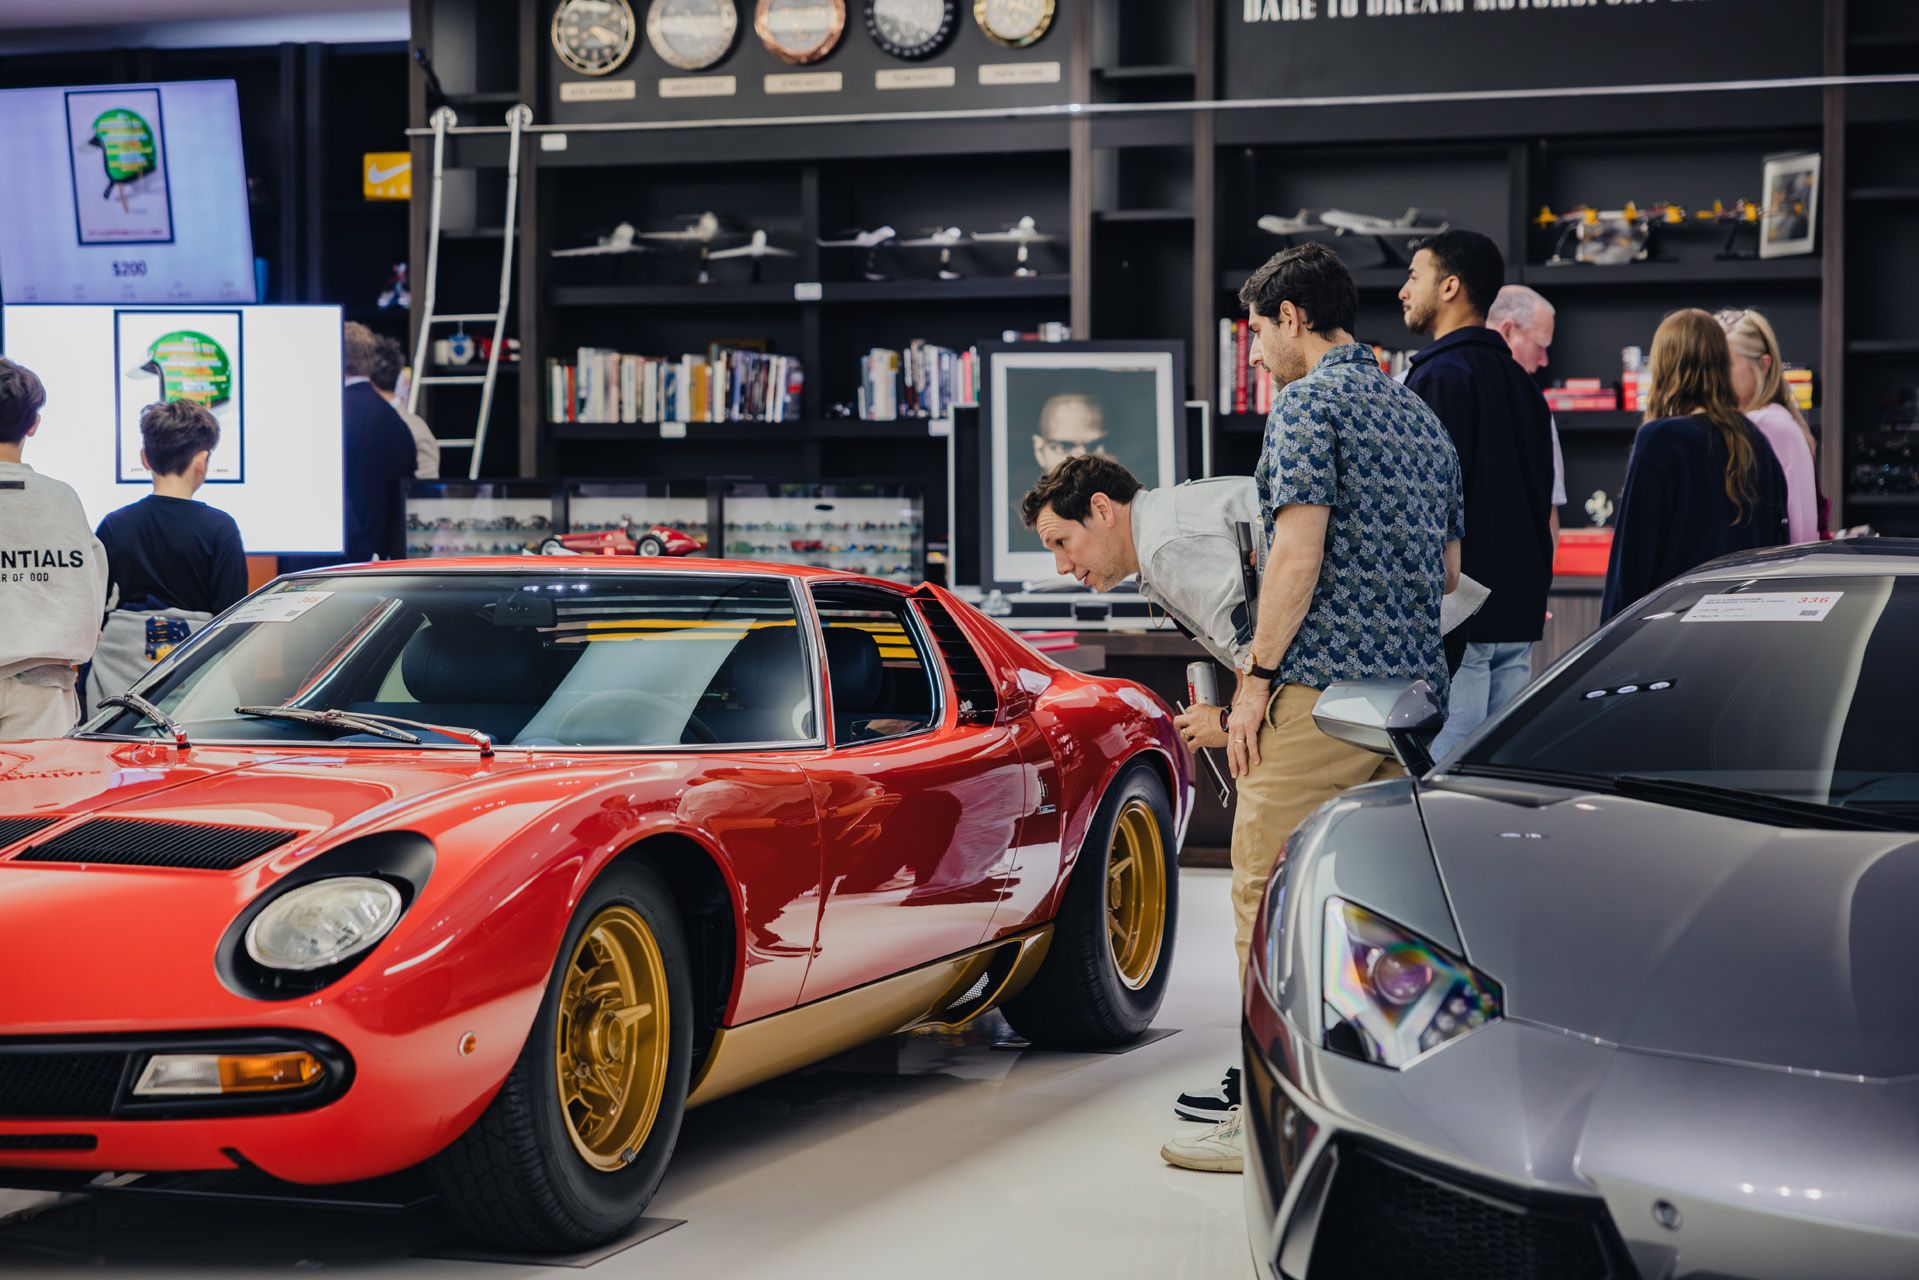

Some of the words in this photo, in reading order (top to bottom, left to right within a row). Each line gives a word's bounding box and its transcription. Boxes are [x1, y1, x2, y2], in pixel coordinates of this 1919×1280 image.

[1243, 0, 1317, 23] DARE
[1327, 0, 1359, 19] TO
[112, 260, 148, 277] $200
[1, 549, 84, 568] NTIALS
[13, 573, 24, 582] OF
[30, 572, 49, 582] GOD
[1797, 596, 1830, 604] 336
